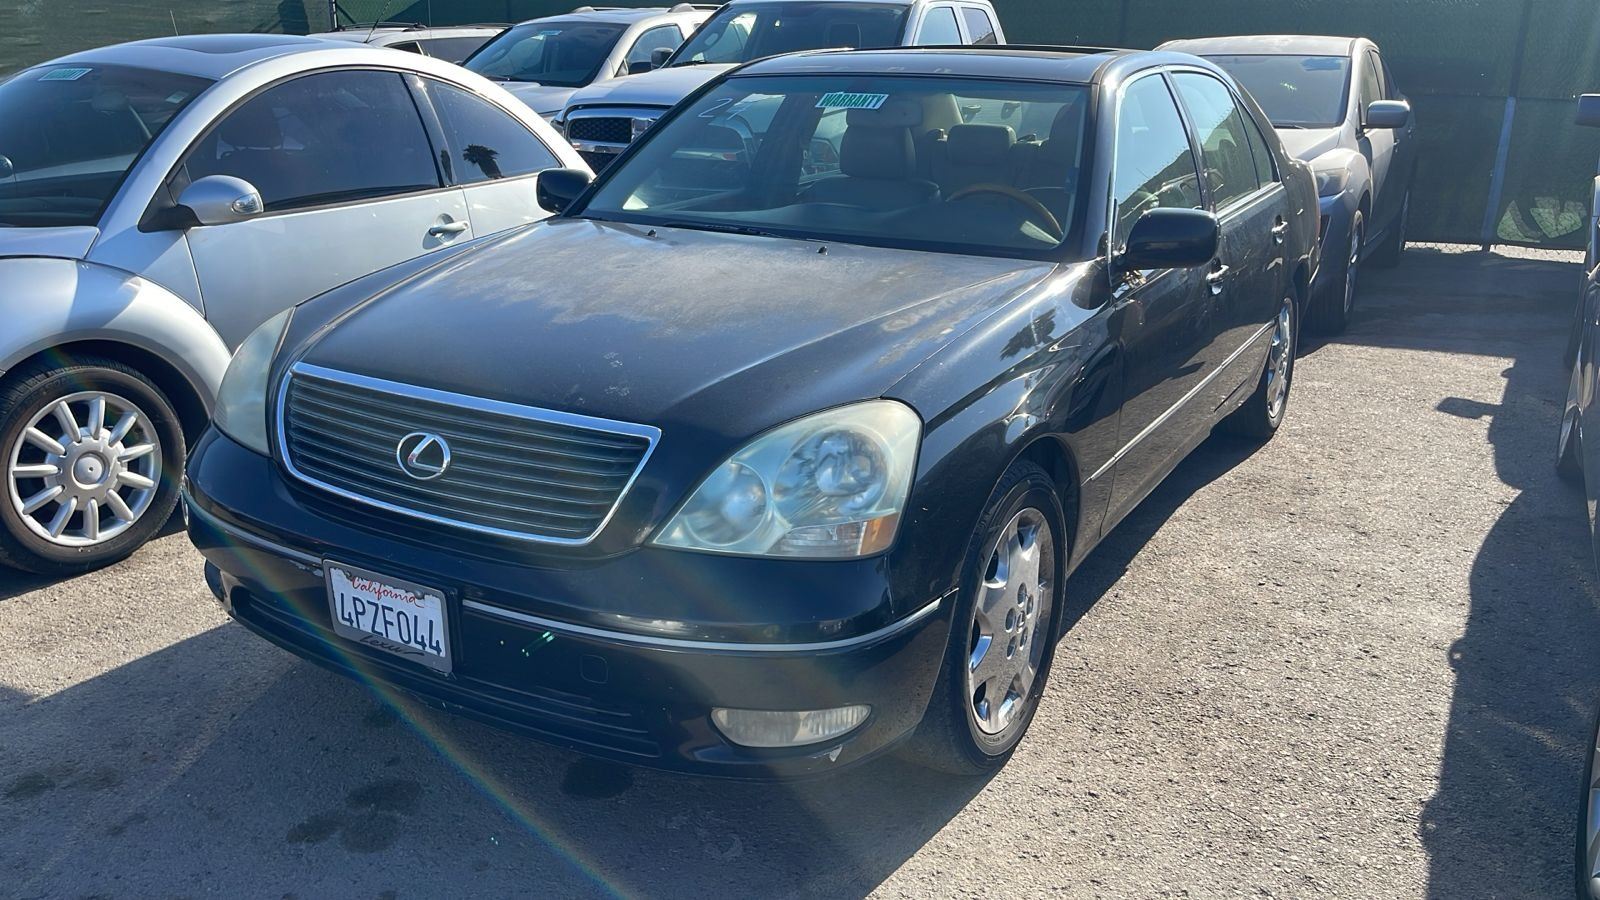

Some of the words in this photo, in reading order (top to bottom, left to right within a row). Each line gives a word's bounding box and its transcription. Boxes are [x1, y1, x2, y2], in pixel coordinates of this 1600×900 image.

[819, 93, 884, 107] WARRANTY
[352, 576, 425, 609] California
[340, 592, 442, 656] 4PZF044
